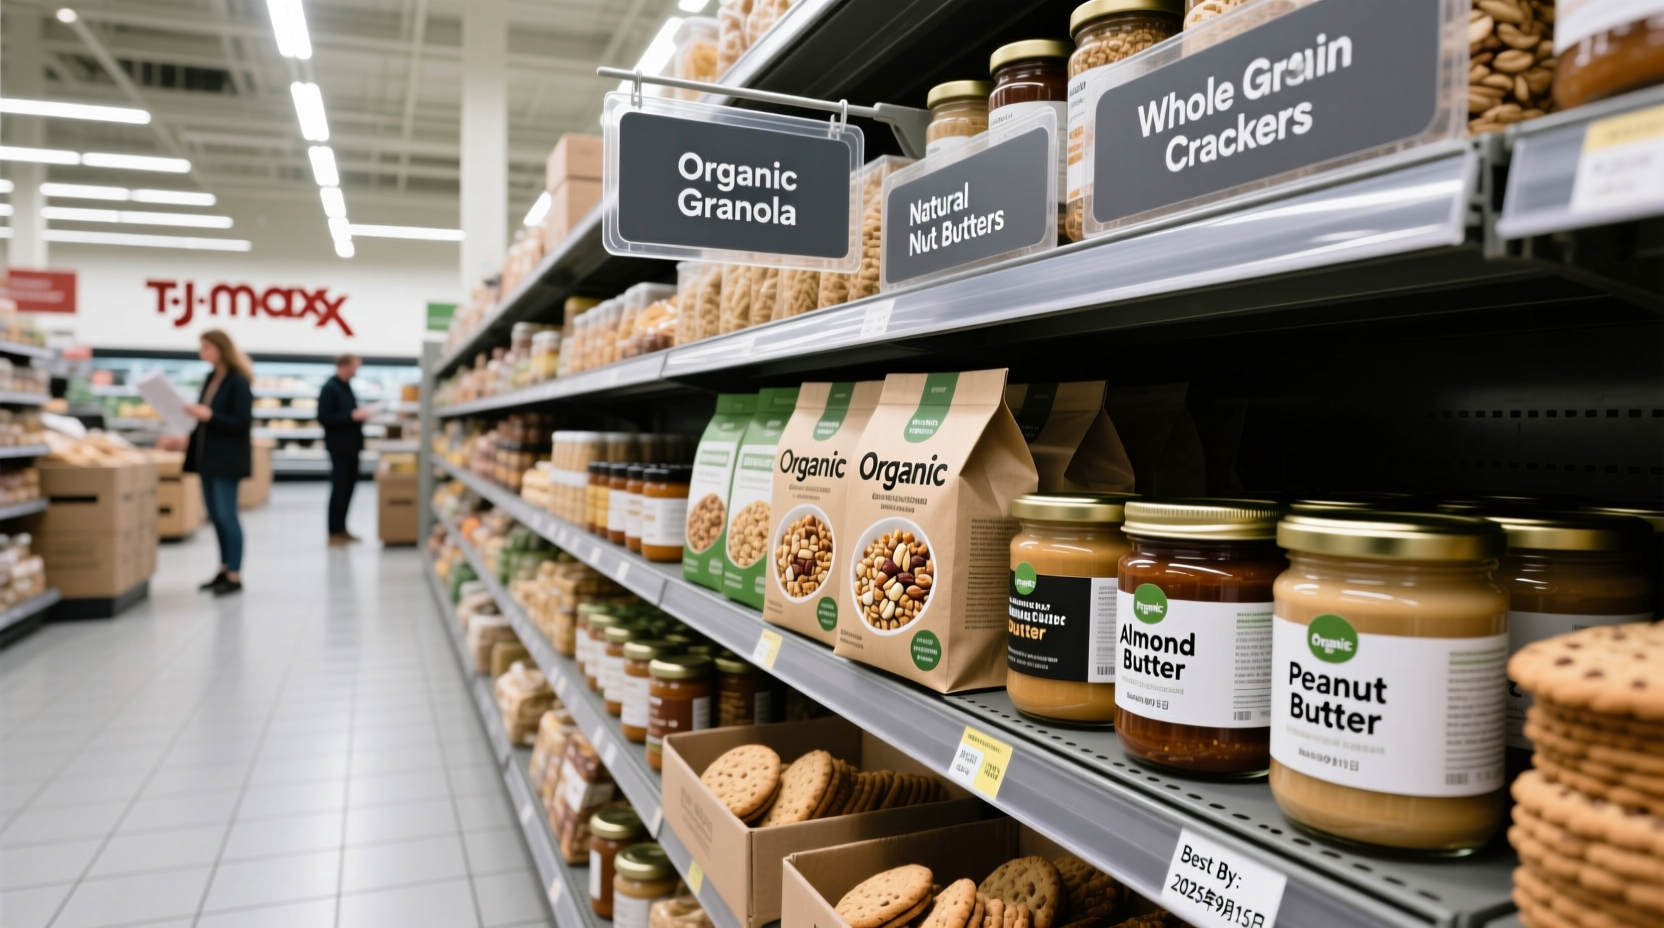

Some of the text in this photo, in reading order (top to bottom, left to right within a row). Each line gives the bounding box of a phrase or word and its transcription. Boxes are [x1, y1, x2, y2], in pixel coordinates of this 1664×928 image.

[1137, 32, 1353, 139] Whole Grain
[1165, 101, 1313, 172] Crackers
[678, 151, 798, 192] Organic
[677, 187, 797, 226] Granola
[909, 181, 969, 227] Natural
[909, 209, 1005, 257] Nut Butters
[780, 448, 848, 483] Organic
[859, 451, 949, 492] Organic
[1119, 622, 1196, 657] Almond
[1123, 647, 1186, 681] Butter
[1289, 660, 1388, 705] Peanut
[1290, 691, 1383, 735] Butter
[1180, 843, 1242, 889] Best By:
